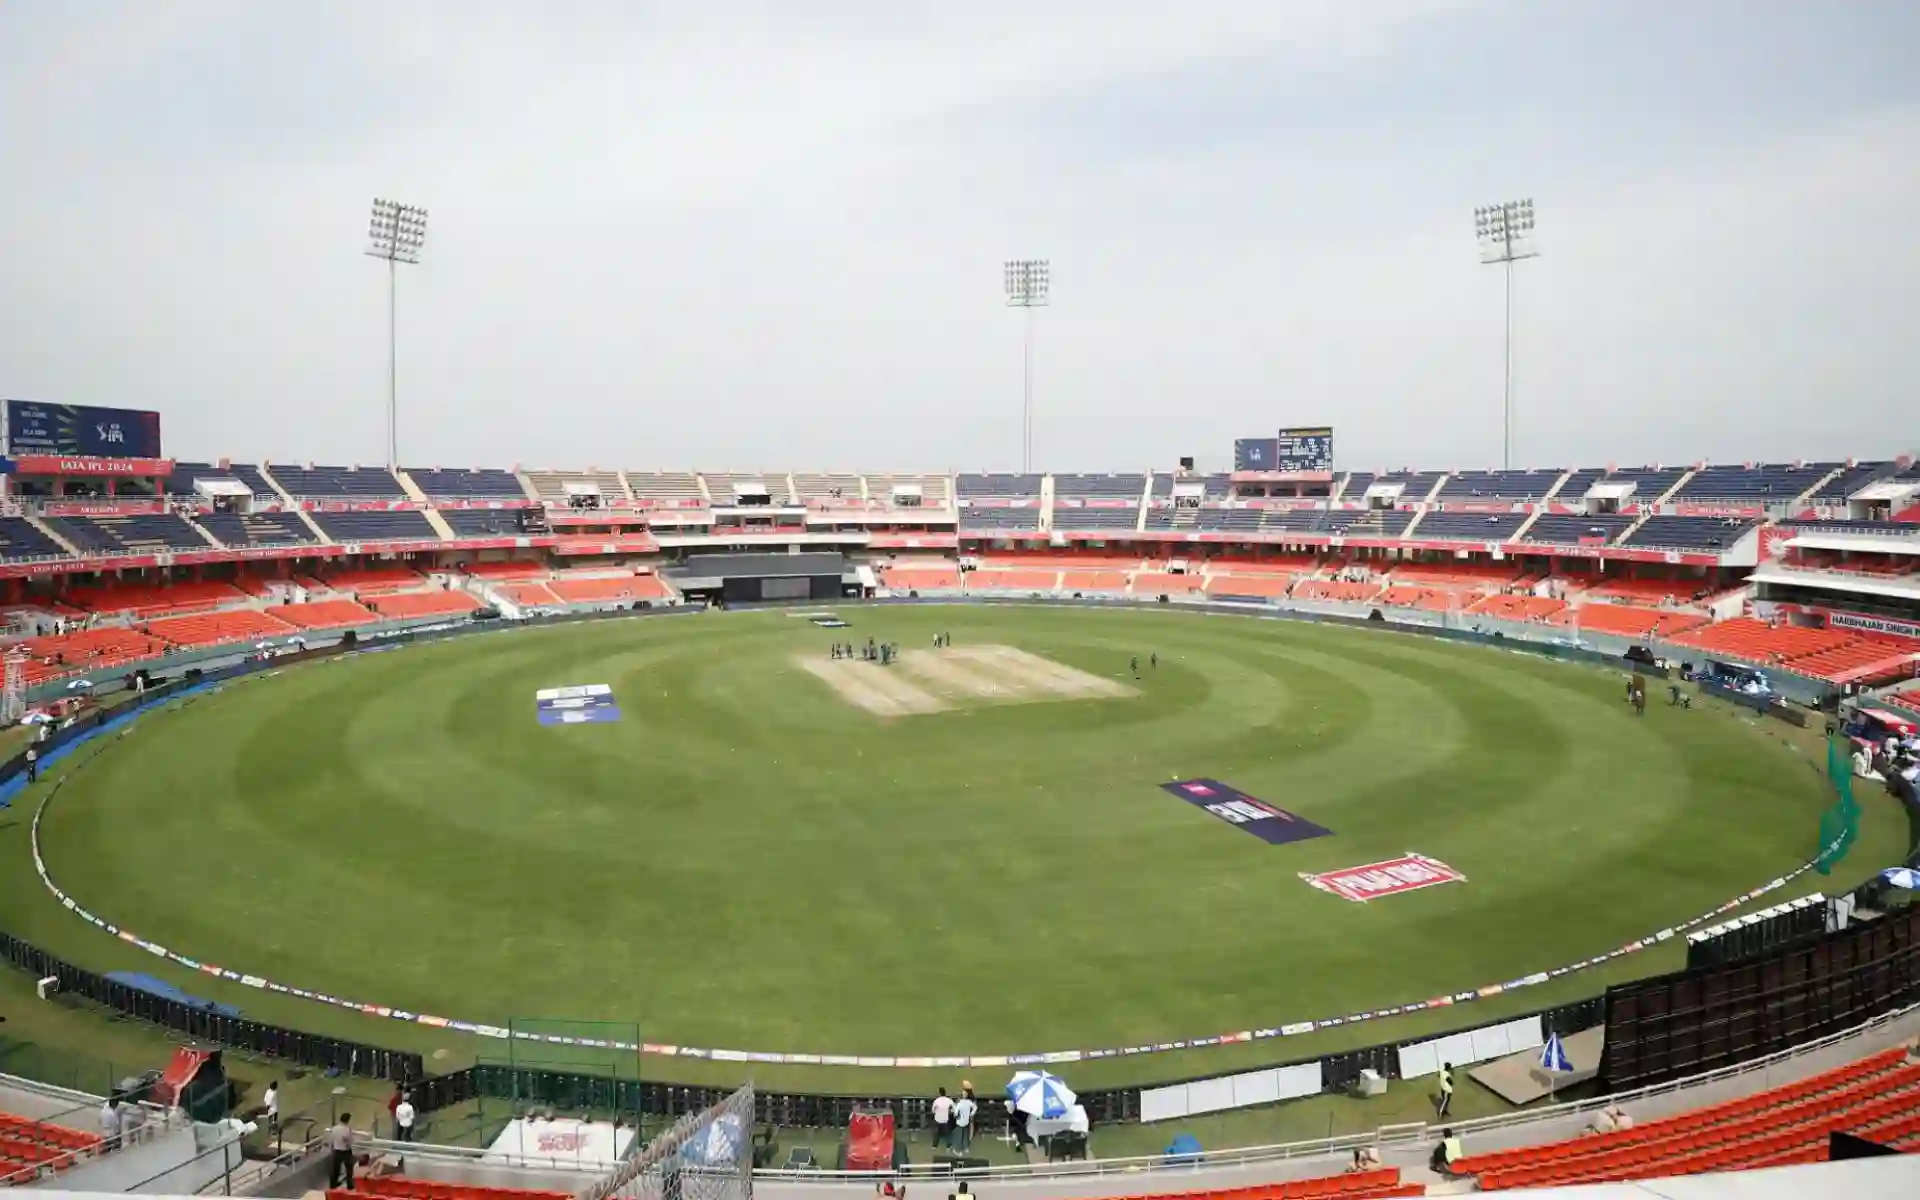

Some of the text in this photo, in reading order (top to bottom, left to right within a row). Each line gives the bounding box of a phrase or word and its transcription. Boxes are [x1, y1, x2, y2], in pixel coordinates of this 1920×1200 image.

[60, 459, 133, 473] TATA IPL 2024
[1832, 616, 1883, 630] HARBHAJAN
